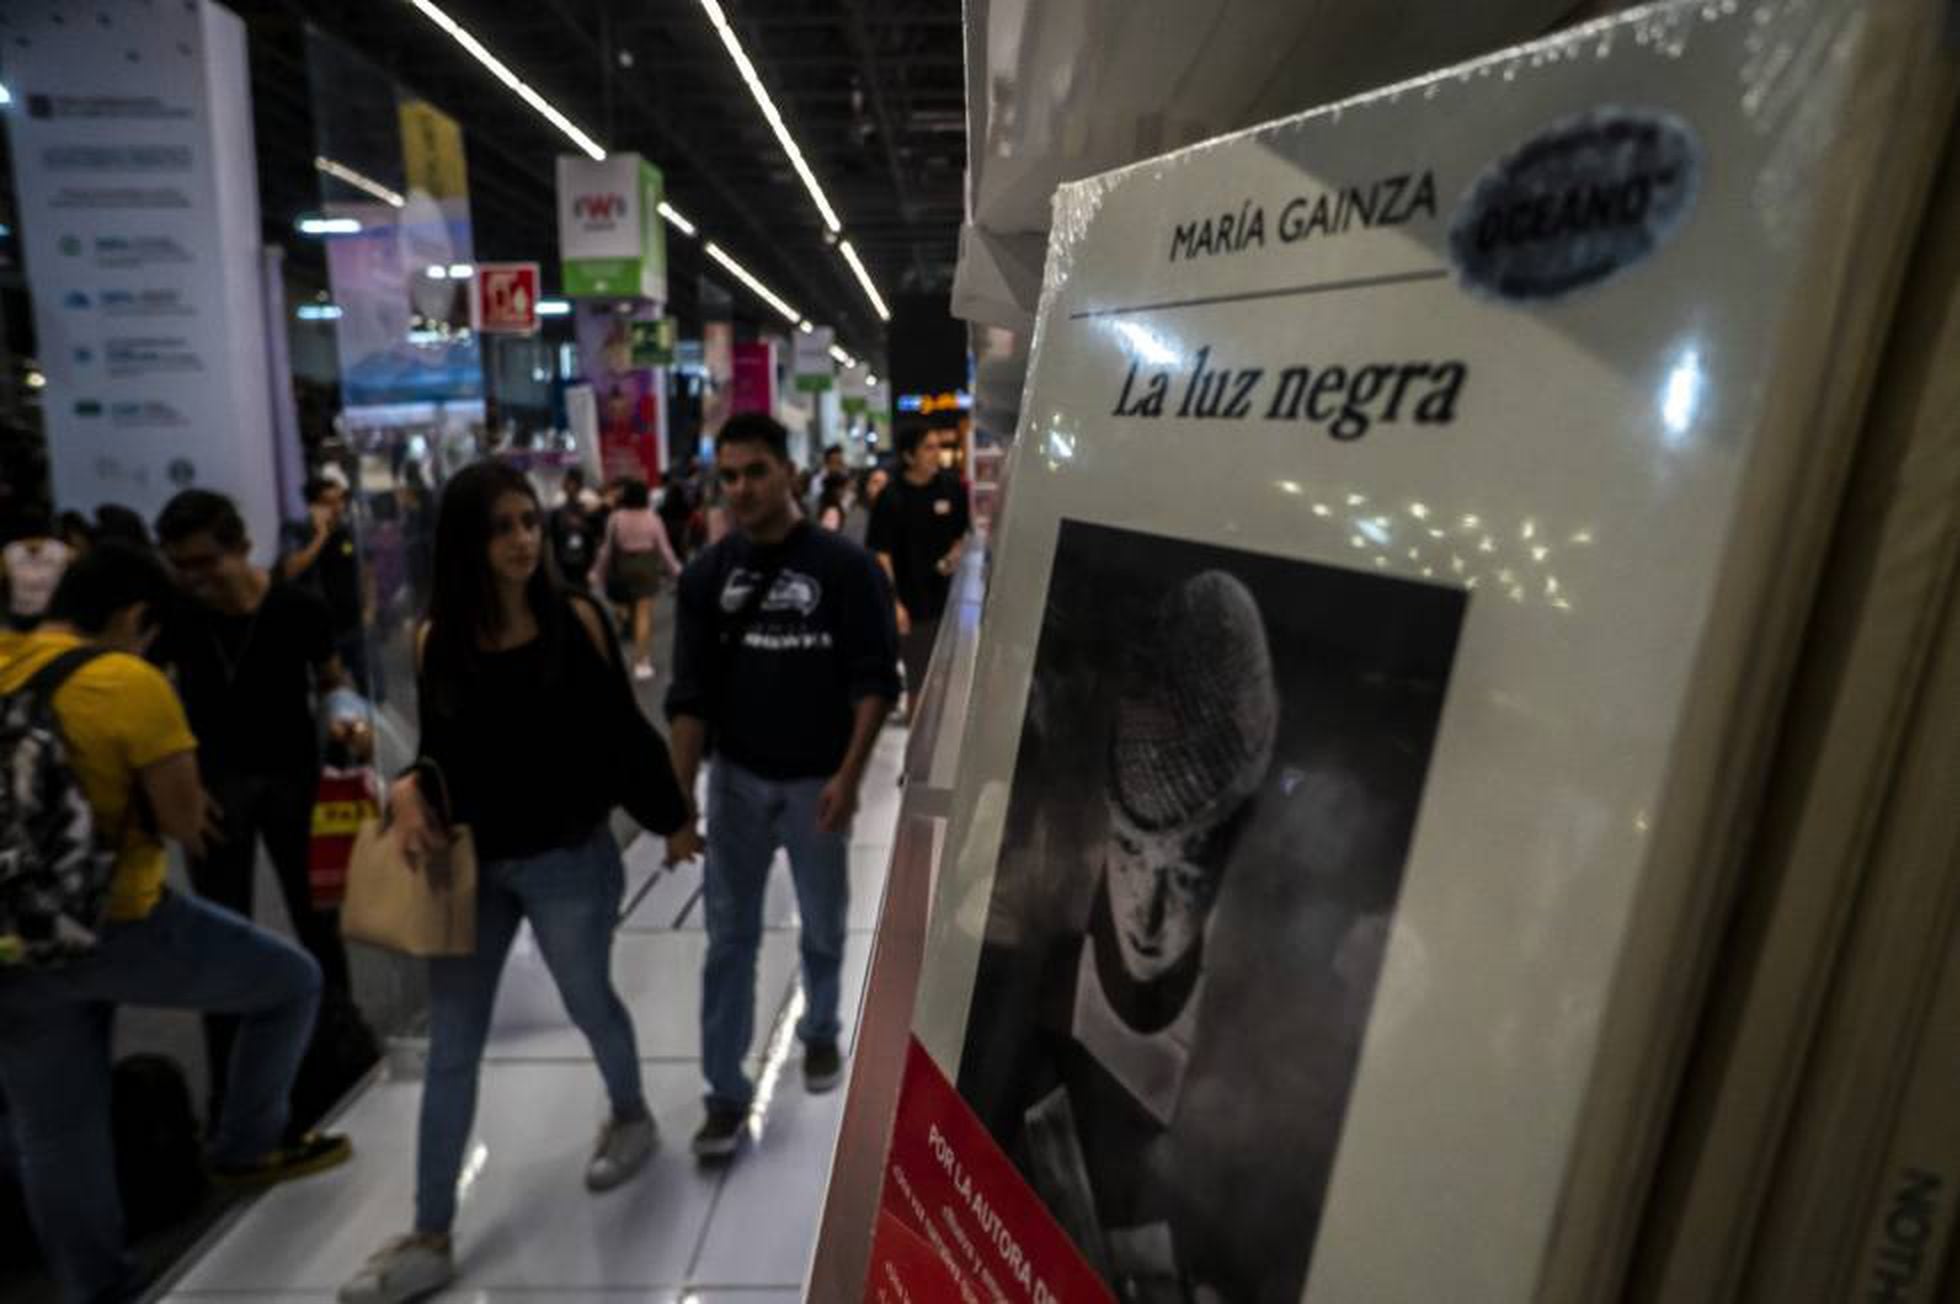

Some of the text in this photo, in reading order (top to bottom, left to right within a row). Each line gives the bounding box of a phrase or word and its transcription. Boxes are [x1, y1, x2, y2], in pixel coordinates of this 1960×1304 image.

[1170, 169, 1438, 262] MARÍA GAINZA
[1111, 345, 1468, 442] La luz negra
[928, 1122, 955, 1174] POR
[953, 1162, 972, 1204] LA
[970, 1191, 1033, 1294] AUTORA
